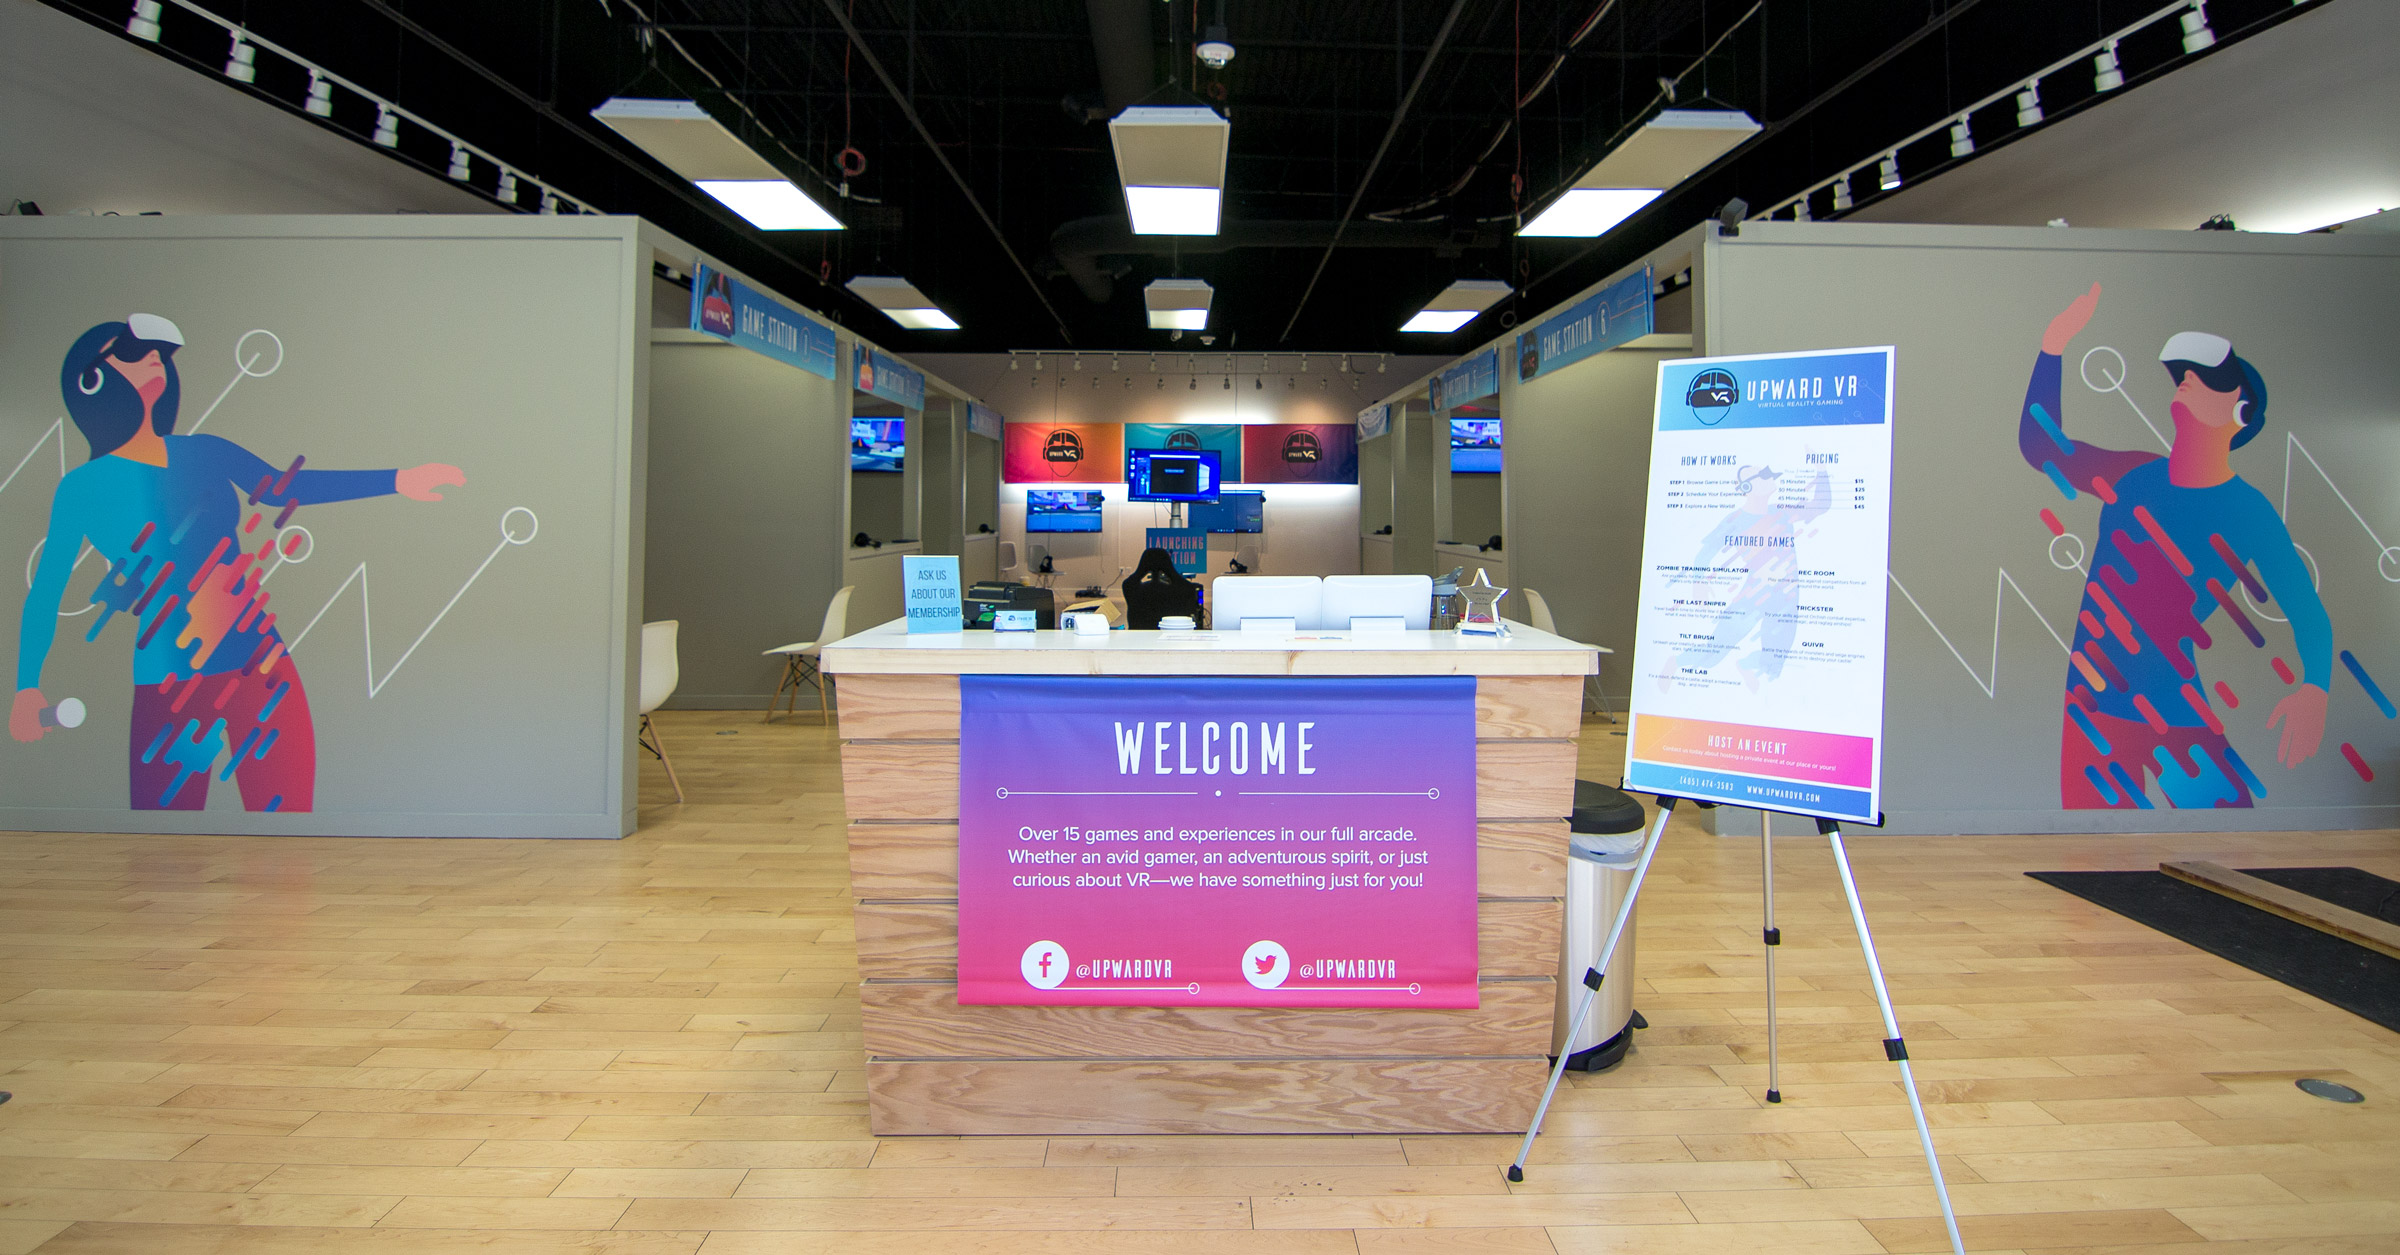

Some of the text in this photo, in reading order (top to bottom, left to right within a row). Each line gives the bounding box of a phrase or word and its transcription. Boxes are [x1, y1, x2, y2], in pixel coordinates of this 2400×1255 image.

[743, 304, 765, 340] GAME
[768, 315, 798, 353] STATION
[1544, 309, 1606, 361] GAME STATION 6
[1747, 375, 1858, 402] UPWARD VR
[1816, 399, 1844, 407] GAMING
[1681, 455, 1737, 466] HOW IT WORKS
[1806, 453, 1839, 464] PRICING
[1724, 535, 1795, 548] FEATURED GAMES
[918, 569, 947, 580] ASK US
[911, 588, 956, 599] ABOUT OUR
[908, 606, 960, 618] MEMBERSHIP
[1115, 722, 1316, 775] WELCOME
[1708, 735, 1787, 755] HOST AN EVENT
[1720, 752, 1740, 760] hosting
[1796, 761, 1811, 769] place
[1747, 785, 1821, 803] WWW.UPWARDVR.COM
[1019, 826, 1417, 845] Over 15 games and experiences in our full arcade.
[1007, 849, 1429, 868] Whether an avid gamer, an adventurous spirit, or just
[1012, 872, 1423, 891] curious about VR—we have something just for you!
[1076, 959, 1173, 979] @UPWARDVR
[1299, 959, 1396, 979] @UPWARDVR
